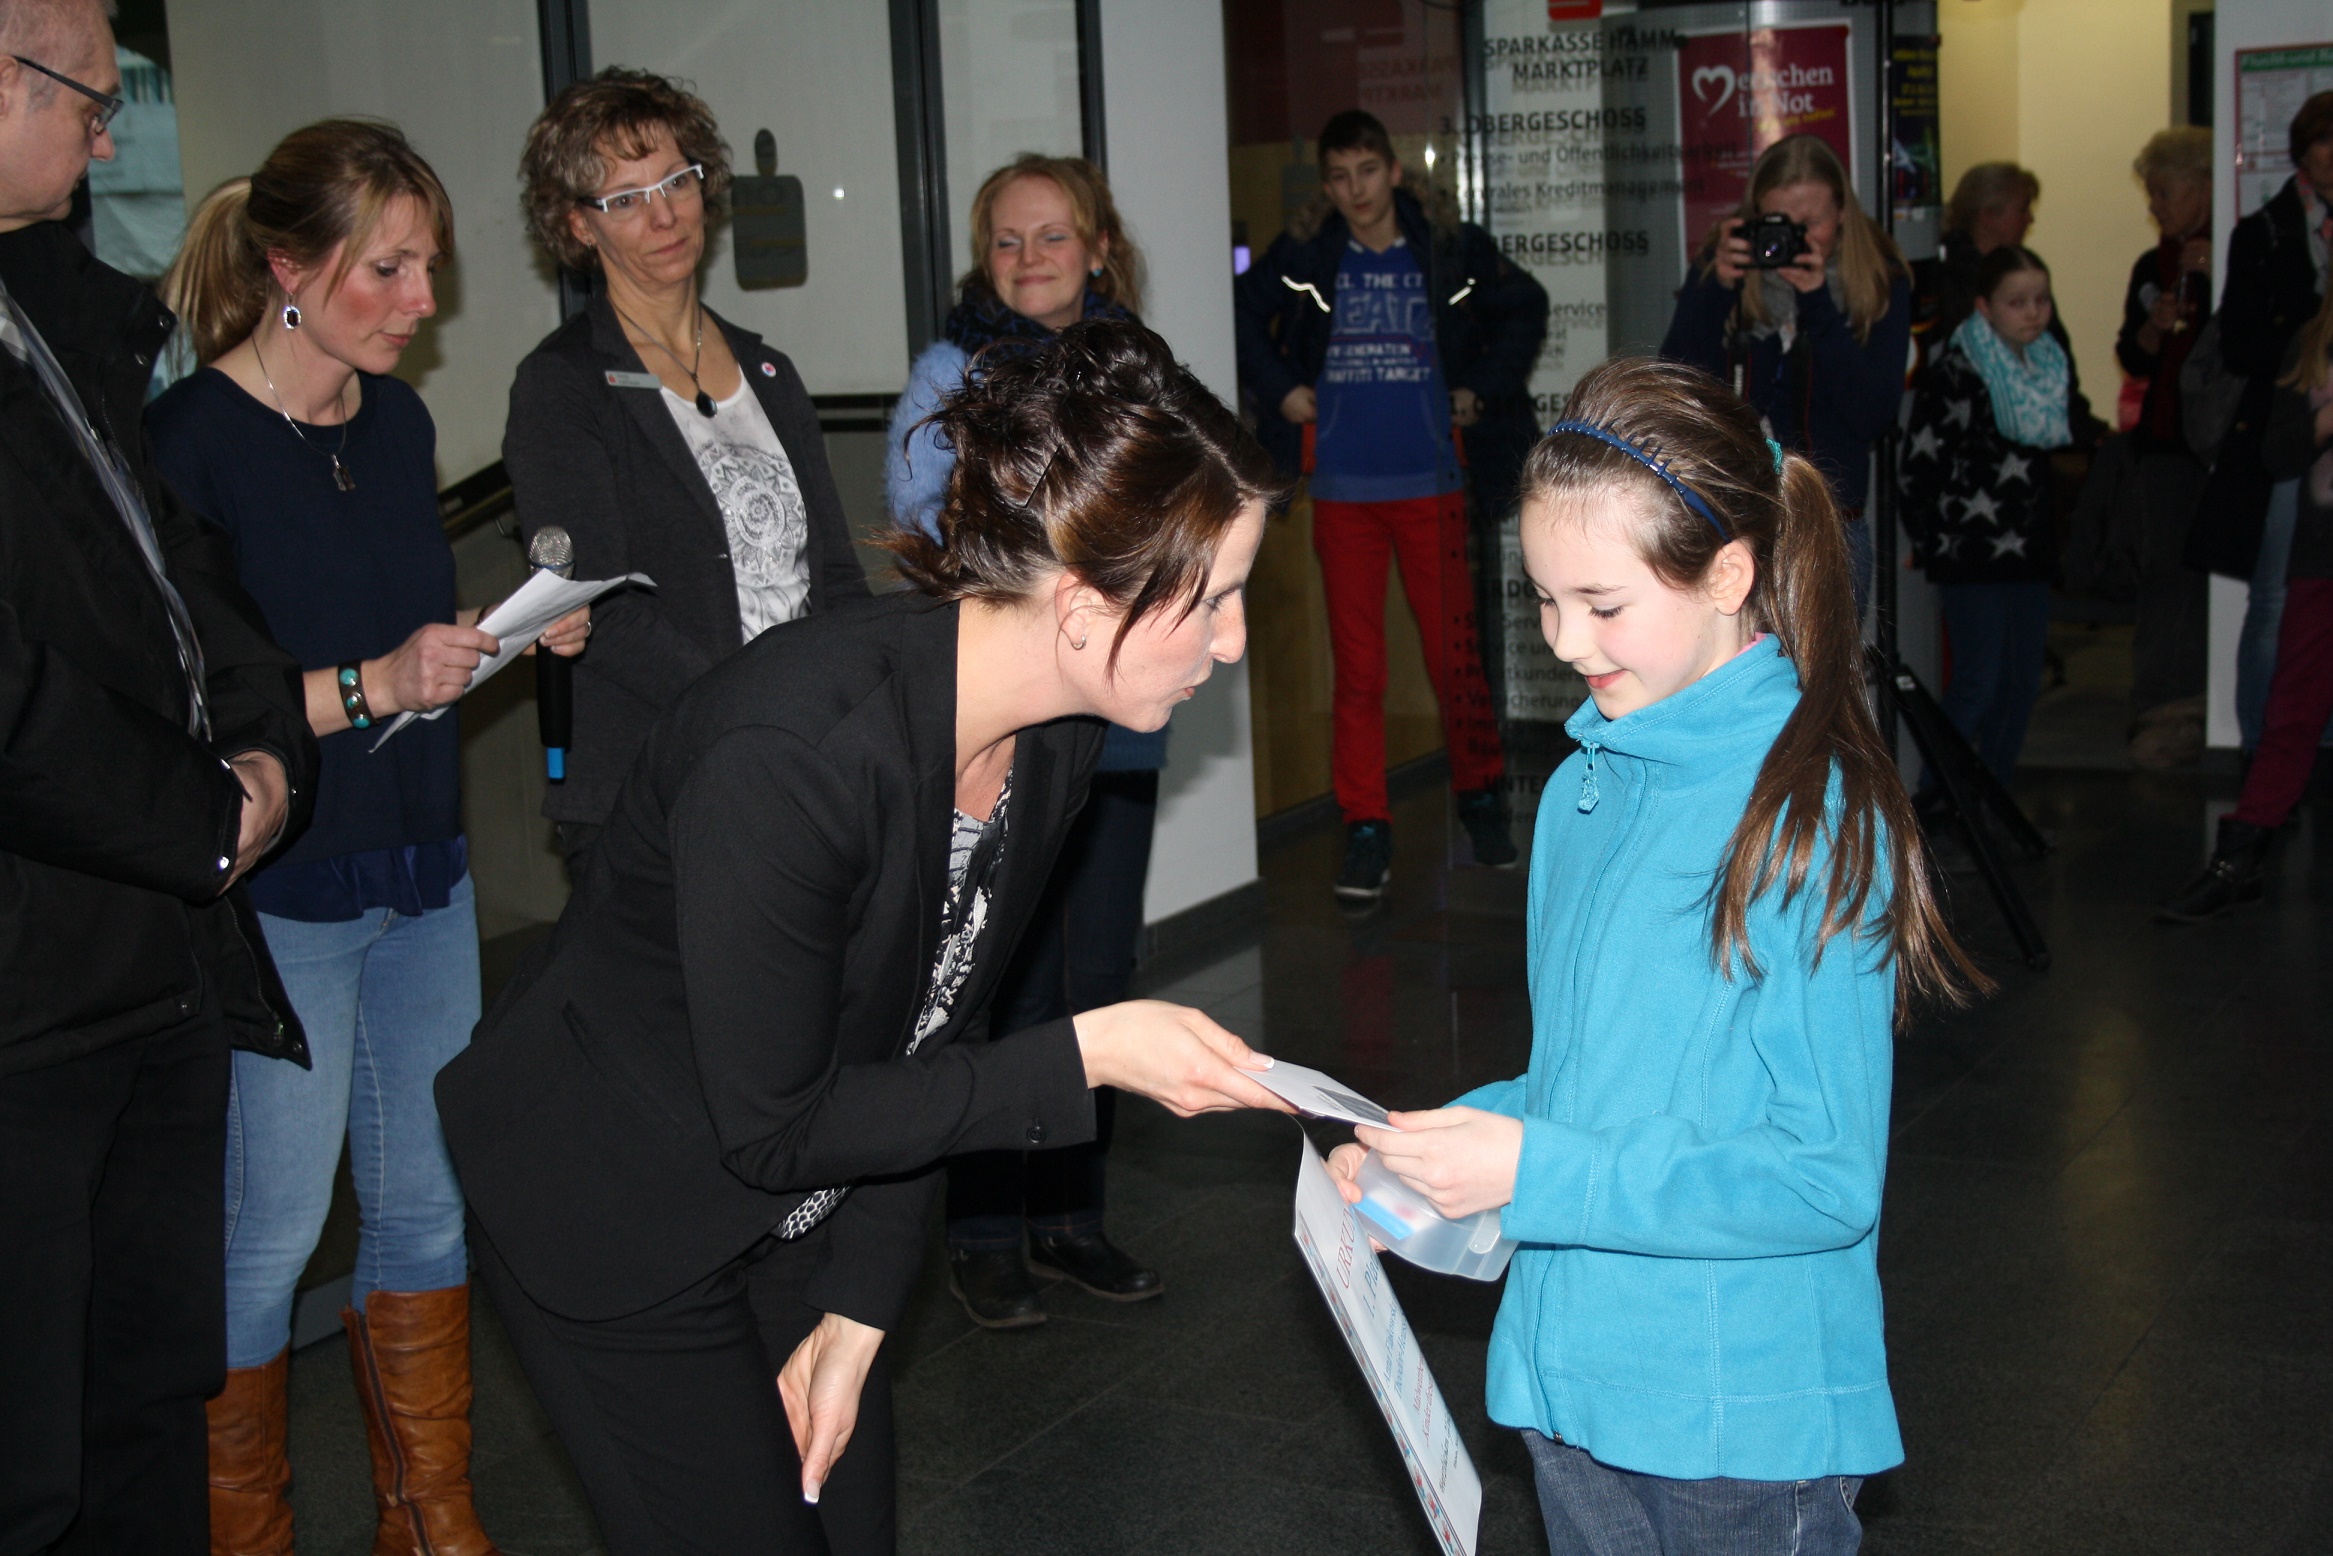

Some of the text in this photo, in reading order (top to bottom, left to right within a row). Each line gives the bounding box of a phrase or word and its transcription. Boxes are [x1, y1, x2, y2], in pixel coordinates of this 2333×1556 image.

[1485, 32, 1601, 57] SPARKASSE
[1513, 56, 1648, 81] MARKTPLATZ
[1772, 91, 1816, 114] Not
[1465, 107, 1647, 135] OBERGESCHOSS
[1364, 1251, 1379, 1300] Plat
